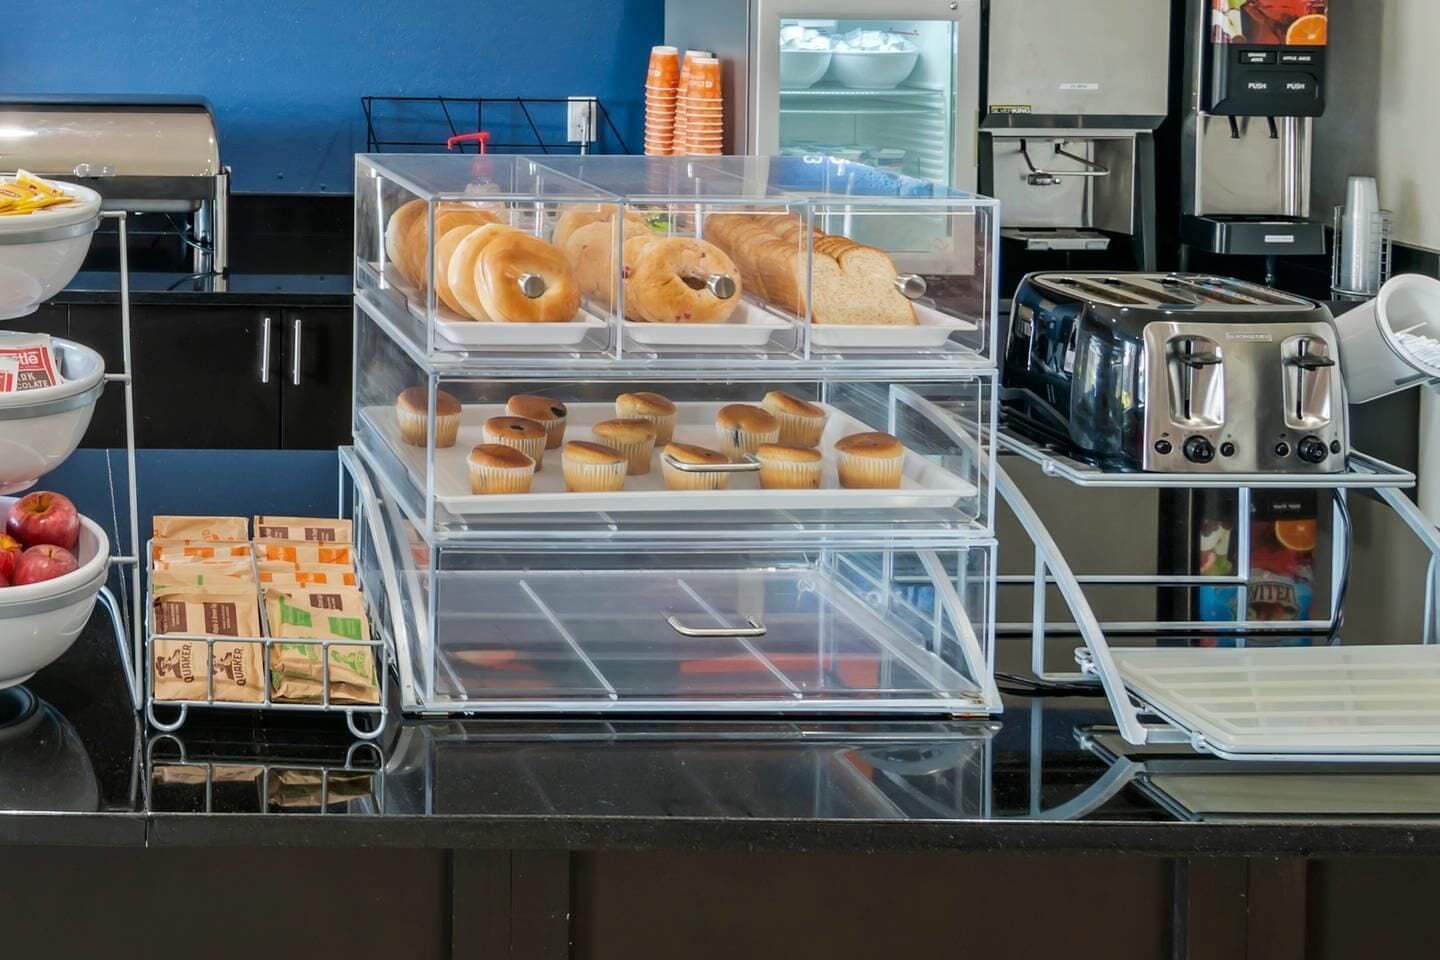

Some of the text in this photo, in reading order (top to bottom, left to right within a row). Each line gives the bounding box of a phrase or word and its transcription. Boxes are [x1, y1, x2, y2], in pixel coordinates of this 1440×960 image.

[17, 380, 49, 390] COLATE
[180, 643, 195, 683] QUAKER
[231, 647, 247, 686] QUAKER
